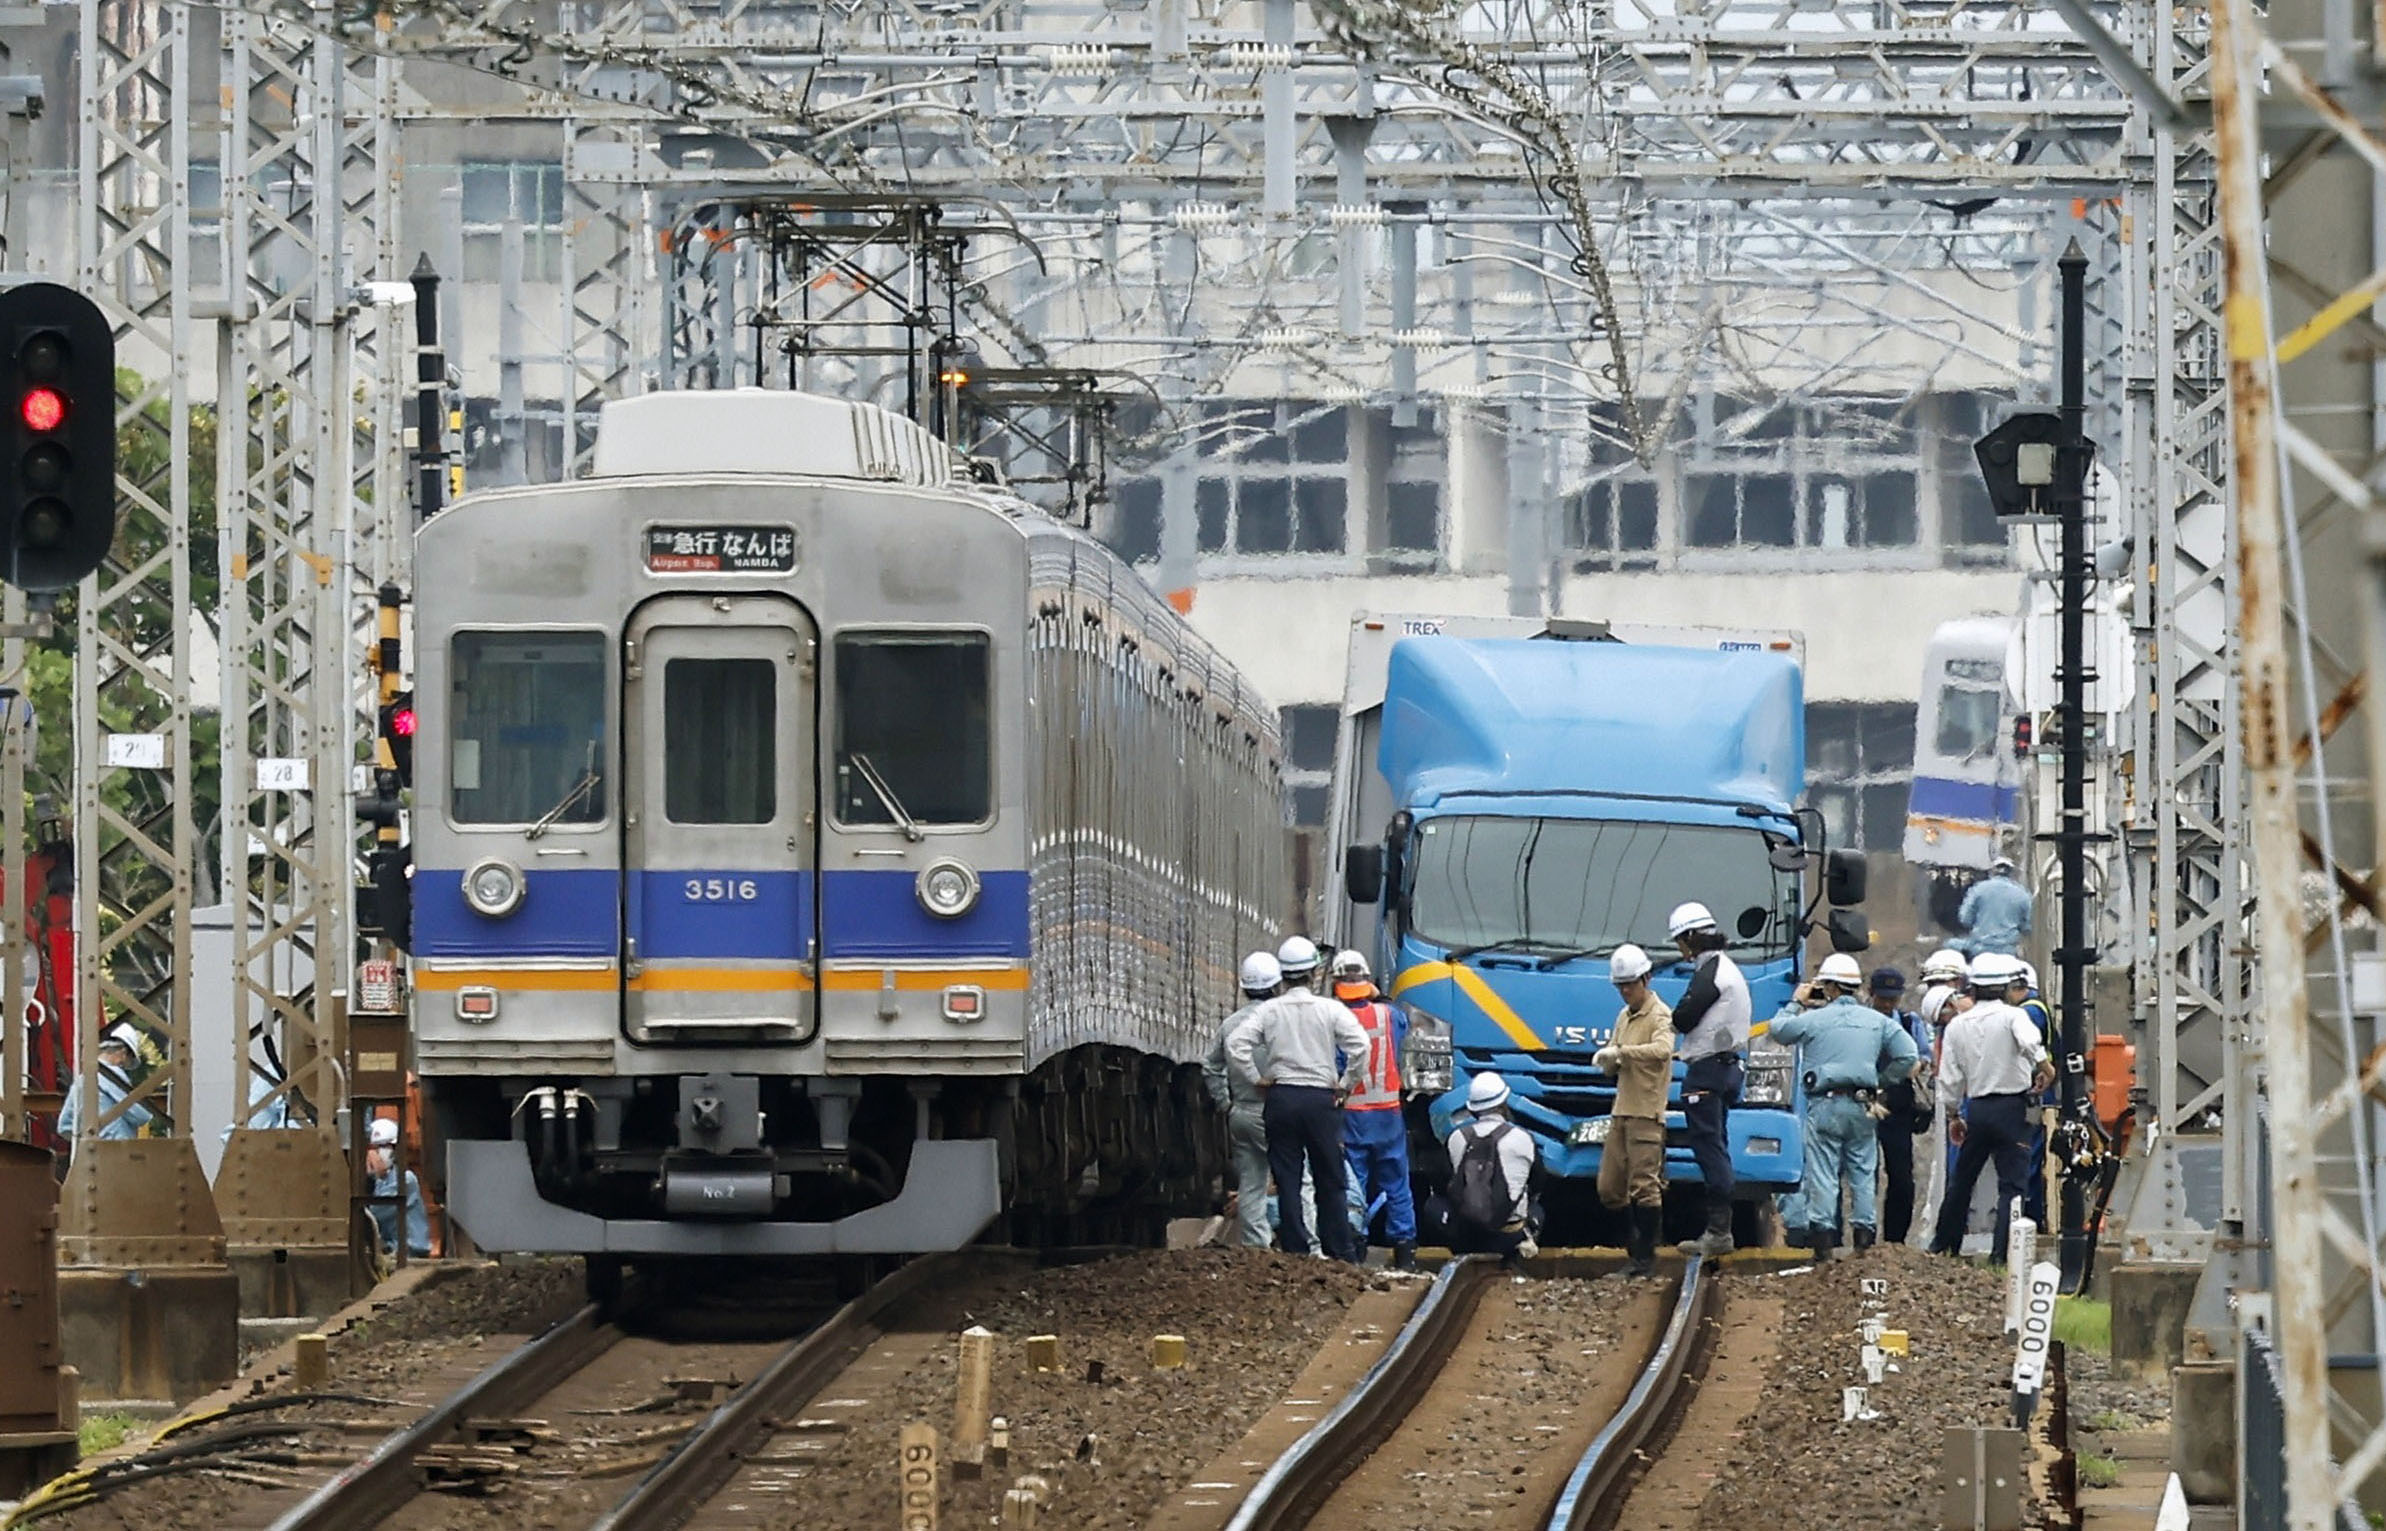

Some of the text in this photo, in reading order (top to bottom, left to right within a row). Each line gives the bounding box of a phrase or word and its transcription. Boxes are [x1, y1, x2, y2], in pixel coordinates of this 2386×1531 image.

[673, 531, 718, 555] 急行
[722, 532, 793, 557] なんば
[734, 557, 779, 568] NAMBA
[685, 879, 757, 900] 3516
[1555, 1026, 1611, 1046] ISU
